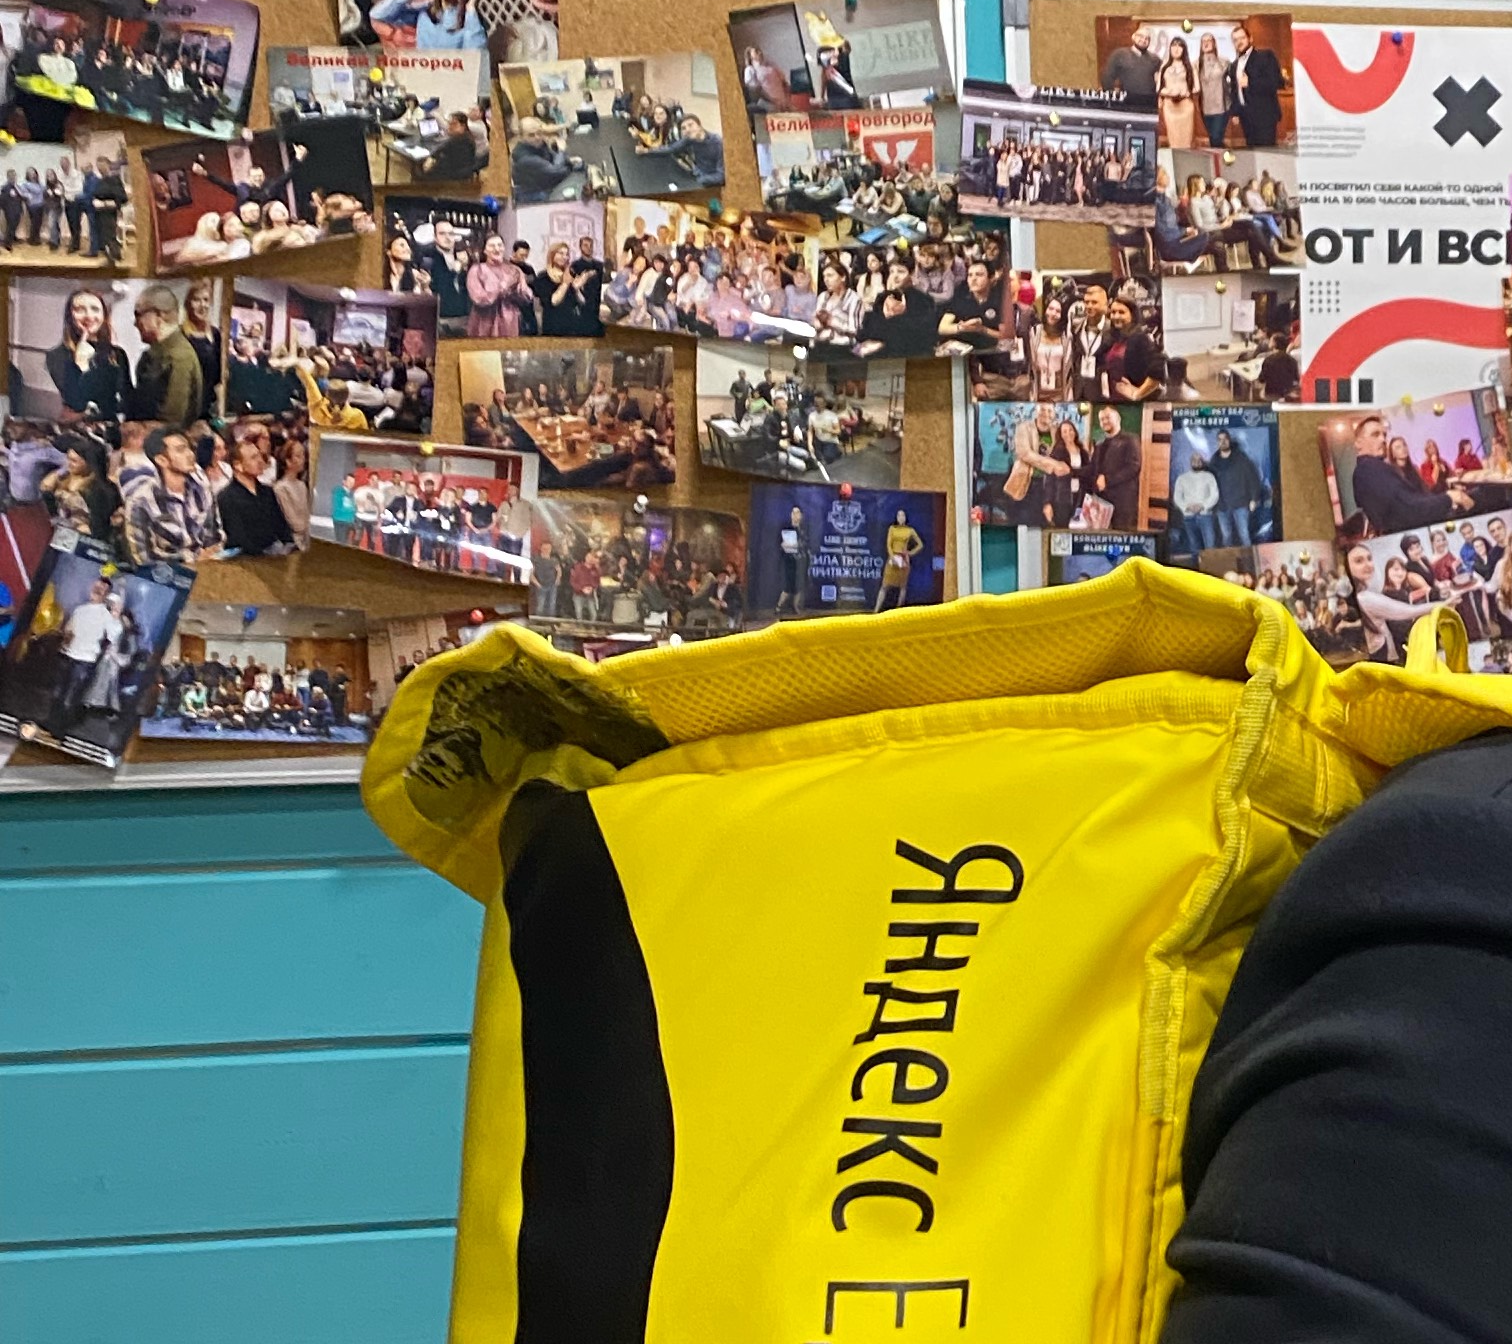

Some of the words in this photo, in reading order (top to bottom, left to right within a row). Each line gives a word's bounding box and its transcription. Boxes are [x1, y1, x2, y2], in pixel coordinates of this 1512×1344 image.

[1310, 182, 1371, 192] ПОСВЯТИЛ
[1373, 183, 1401, 192] СЕБЯ
[1404, 181, 1461, 193] КАКОЙ-ТО
[1463, 182, 1503, 193] ОДНОЙ
[1323, 196, 1340, 204] НА
[1343, 196, 1353, 204] 10
[1379, 196, 1416, 205] ЧАСОВ
[1472, 197, 1495, 205] ЧЕМ
[1387, 228, 1422, 265] И
[830, 838, 1025, 1234] Яндекс
